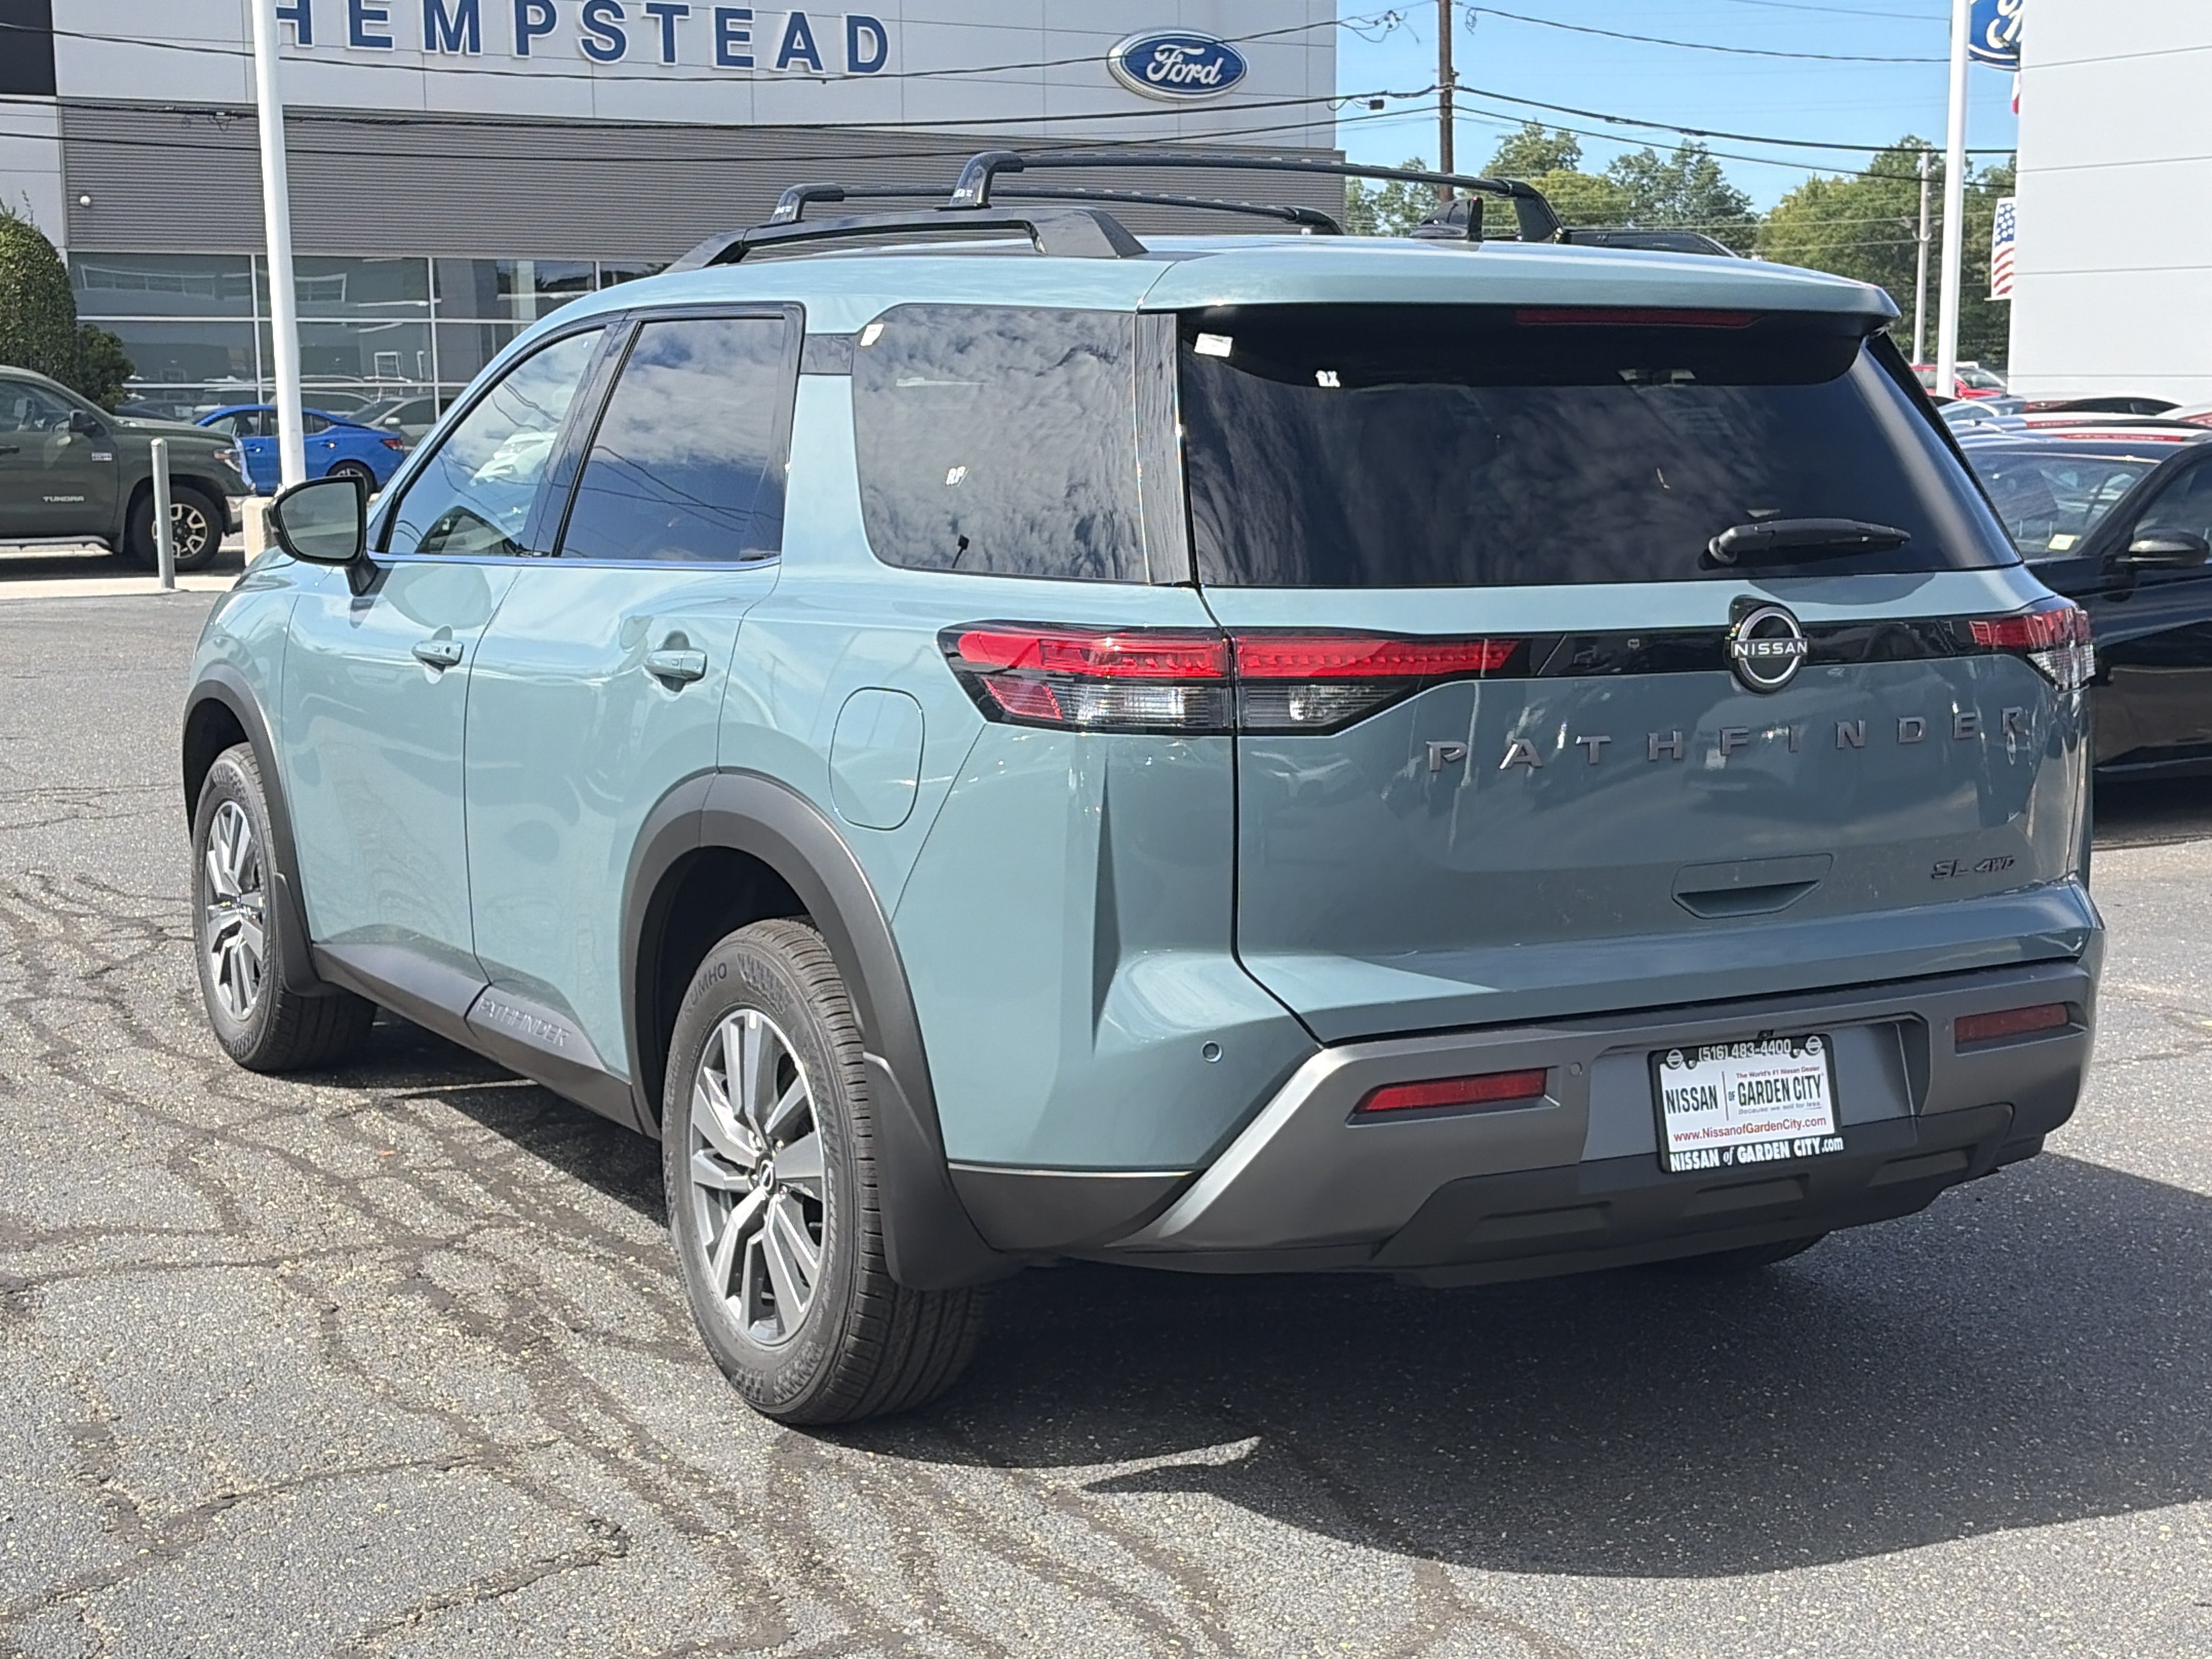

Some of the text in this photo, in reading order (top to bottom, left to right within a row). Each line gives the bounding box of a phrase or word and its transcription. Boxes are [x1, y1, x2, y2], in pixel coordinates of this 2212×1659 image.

[276, 0, 889, 75] HEMPSTEAD
[1147, 44, 1224, 84] Ford
[1734, 641, 1808, 657] NISSAN
[1426, 706, 2029, 771] PATHFINDER
[1931, 859, 1968, 879] SL
[1698, 1039, 1791, 1062] (516) 483-4400
[1664, 1084, 1718, 1114] NISSAN
[1737, 1077, 1791, 1107] GARDEN
[1792, 1074, 1821, 1101] CITY
[1739, 1107, 1768, 1115] Because
[1673, 1118, 1827, 1142] www.NissanofGardenCity.com
[1669, 1137, 1844, 1172] NISSAN of GARDEN CITY.com
